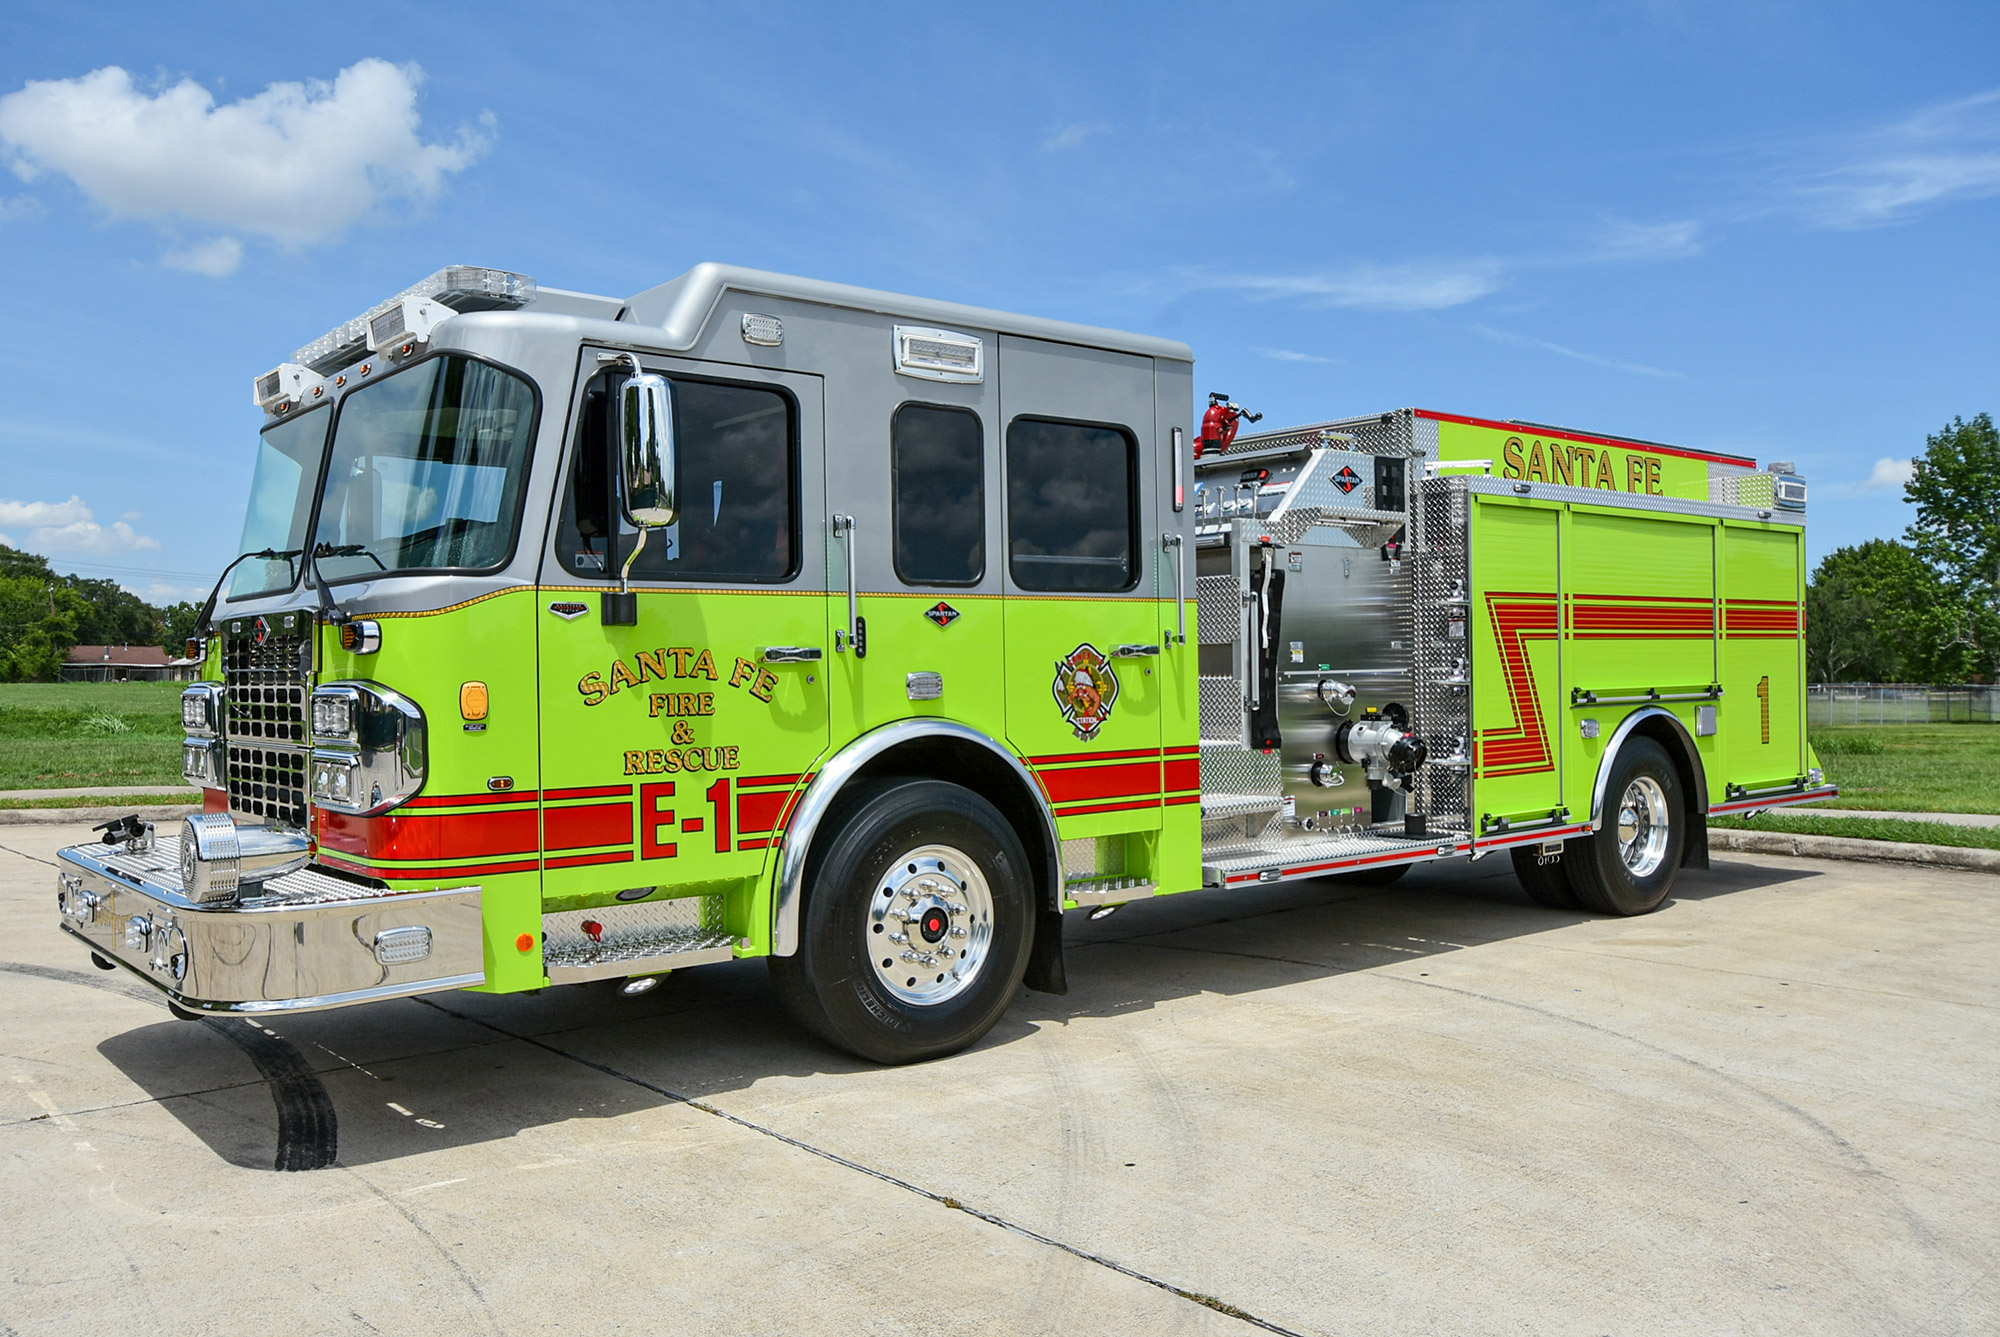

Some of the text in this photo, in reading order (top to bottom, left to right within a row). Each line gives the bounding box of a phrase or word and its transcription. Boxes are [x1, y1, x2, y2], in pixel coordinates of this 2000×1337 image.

[1335, 476, 1359, 484] SPARTAN
[1503, 437, 1664, 497] SANTA FE
[578, 647, 780, 706] SANTA FE
[648, 692, 716, 718] FIRE
[1756, 675, 1770, 744] 1
[671, 719, 695, 745] &
[623, 745, 741, 775] RESCUE
[640, 778, 731, 861] E-1
